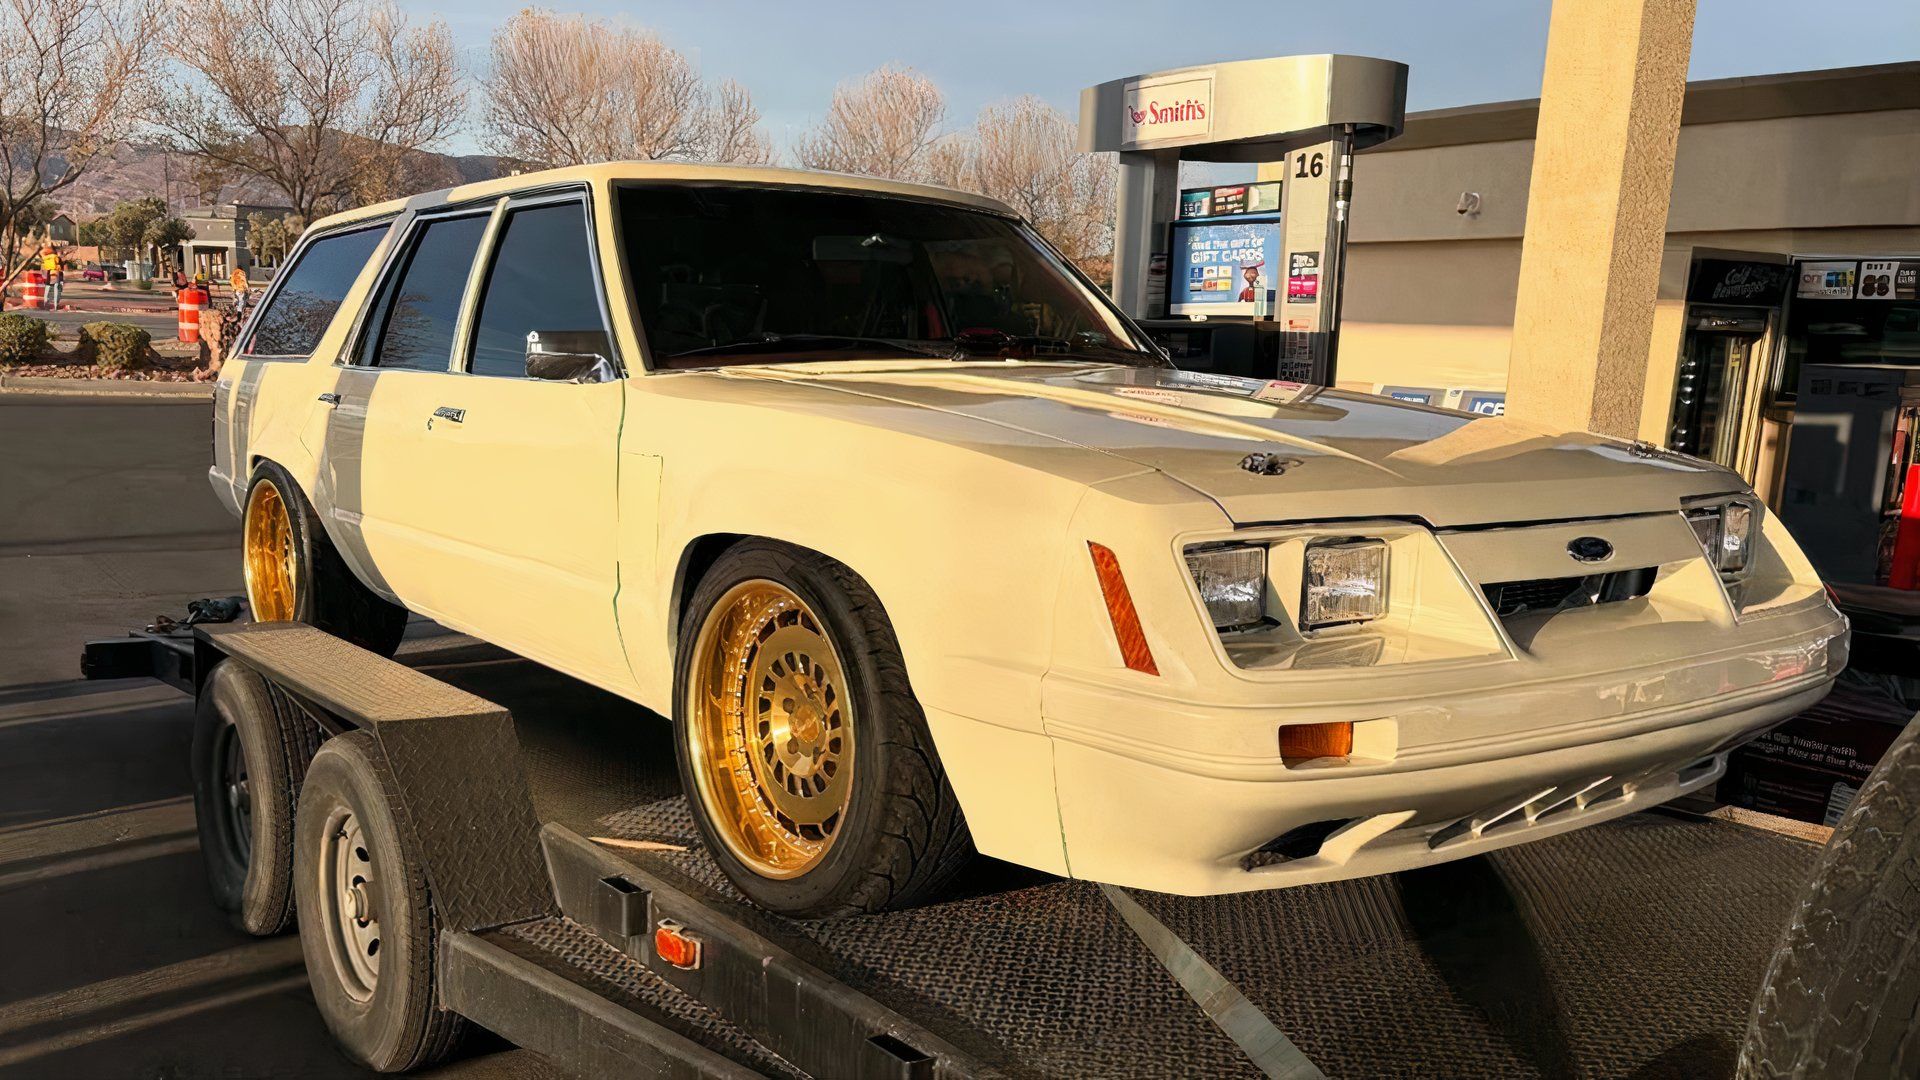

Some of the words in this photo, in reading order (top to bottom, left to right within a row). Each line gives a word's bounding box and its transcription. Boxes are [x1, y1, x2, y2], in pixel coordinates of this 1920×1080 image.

[1149, 100, 1205, 124] Smith's
[1296, 153, 1323, 178] 16
[1191, 251, 1218, 263] GIFT
